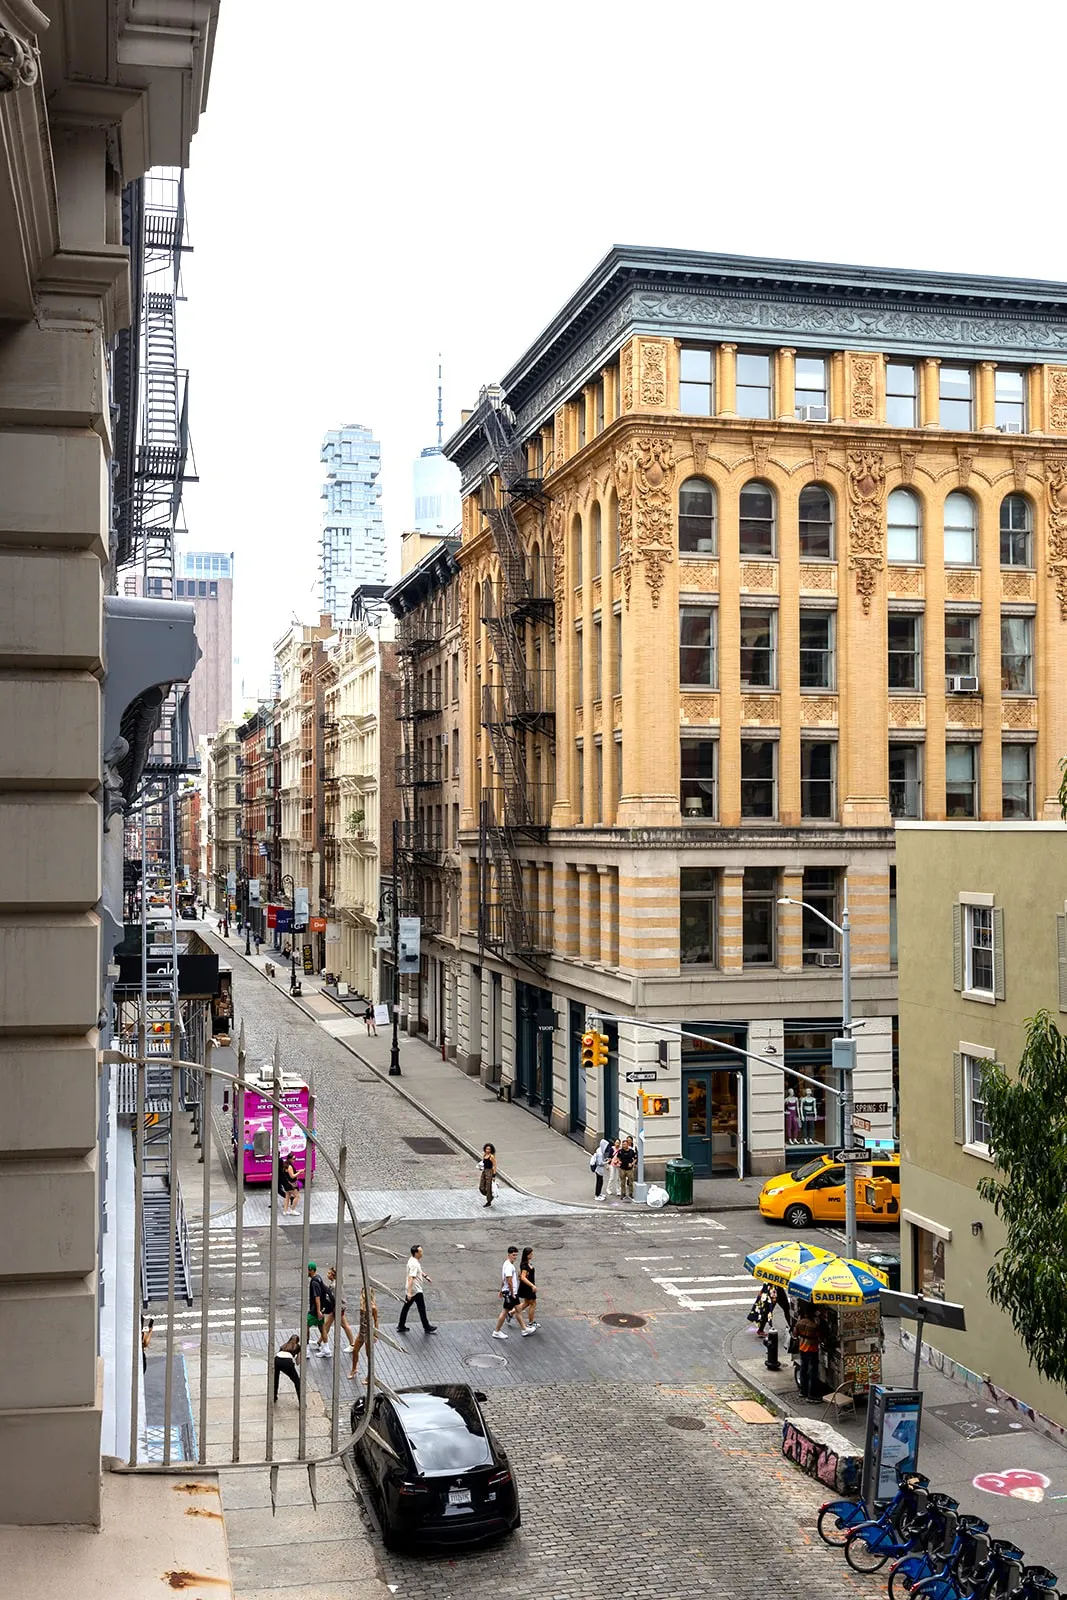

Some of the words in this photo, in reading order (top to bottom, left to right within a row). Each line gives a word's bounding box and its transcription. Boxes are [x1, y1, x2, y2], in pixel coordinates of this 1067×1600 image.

[855, 1104, 877, 1112] SPRING
[878, 1103, 886, 1112] ST
[756, 1269, 790, 1286] SABRET
[814, 1292, 860, 1303] SABRETT
